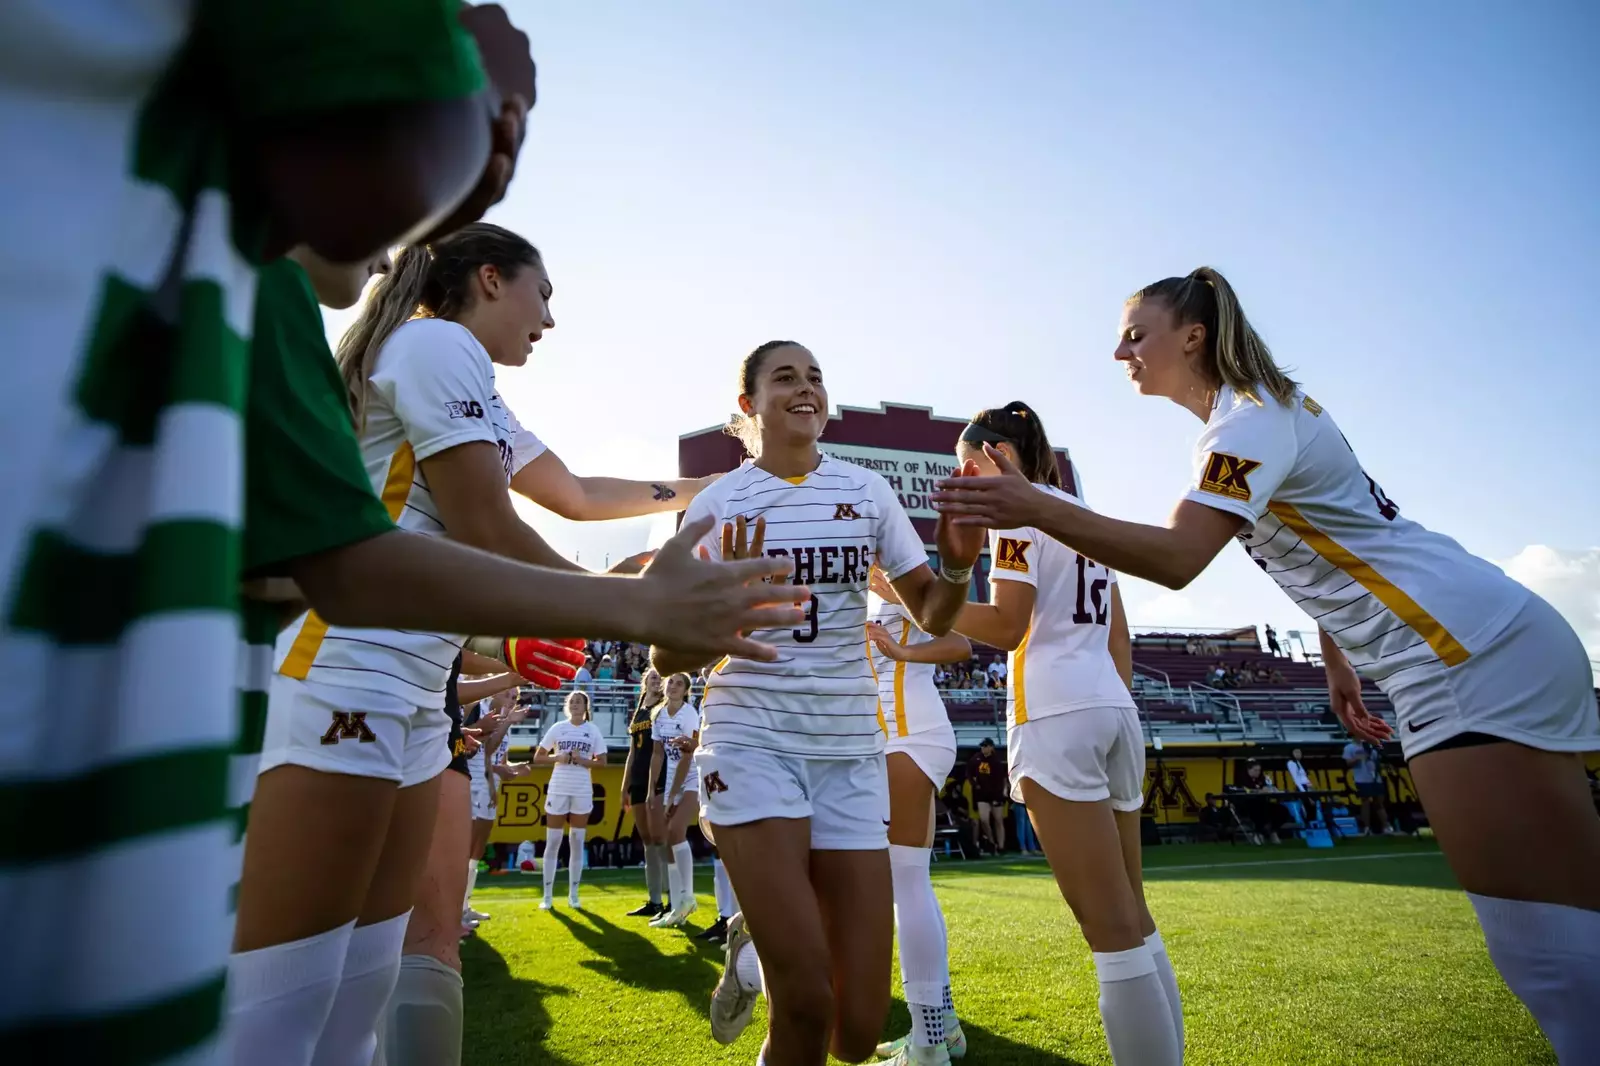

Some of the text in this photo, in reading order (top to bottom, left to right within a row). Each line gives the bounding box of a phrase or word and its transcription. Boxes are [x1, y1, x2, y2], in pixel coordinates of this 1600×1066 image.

[825, 452, 956, 477] VERSITY OF MIN
[1200, 451, 1262, 499] IX
[911, 477, 940, 493] LYL
[833, 503, 861, 520] M
[997, 537, 1032, 569] IX
[1072, 553, 1108, 625] 12
[320, 710, 376, 745] M
[557, 740, 592, 753] GOPHERS
